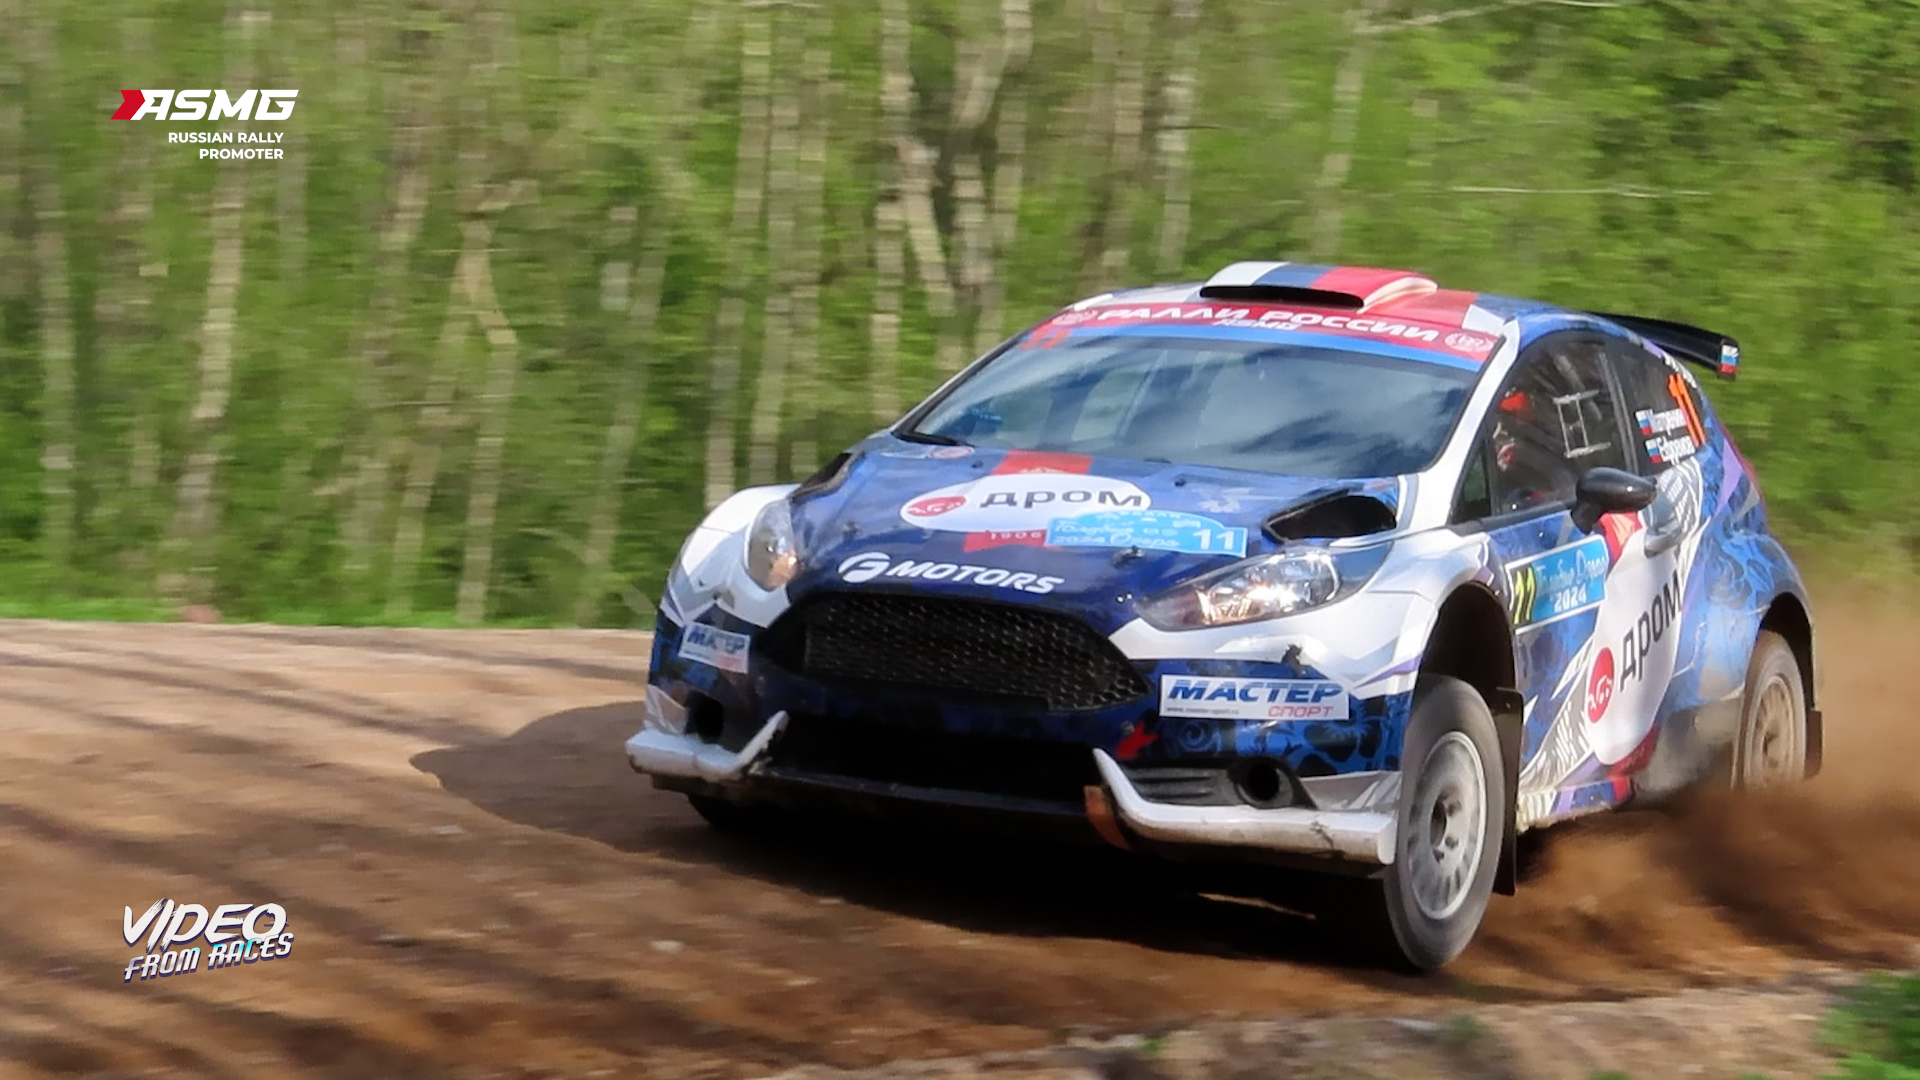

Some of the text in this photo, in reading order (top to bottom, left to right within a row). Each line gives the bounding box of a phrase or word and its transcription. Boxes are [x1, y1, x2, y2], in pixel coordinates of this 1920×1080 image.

[1097, 307, 1250, 320] РАЛЛИ
[1260, 310, 1440, 342] РОССИИ
[1667, 372, 1706, 448] 11
[1193, 529, 1235, 550] 11
[886, 560, 1065, 594] MOTORS
[1513, 567, 1535, 624] 11
[1554, 583, 1587, 613] 2024
[1168, 679, 1343, 703] МАСТЕР
[1268, 705, 1334, 717] СПОРТ
